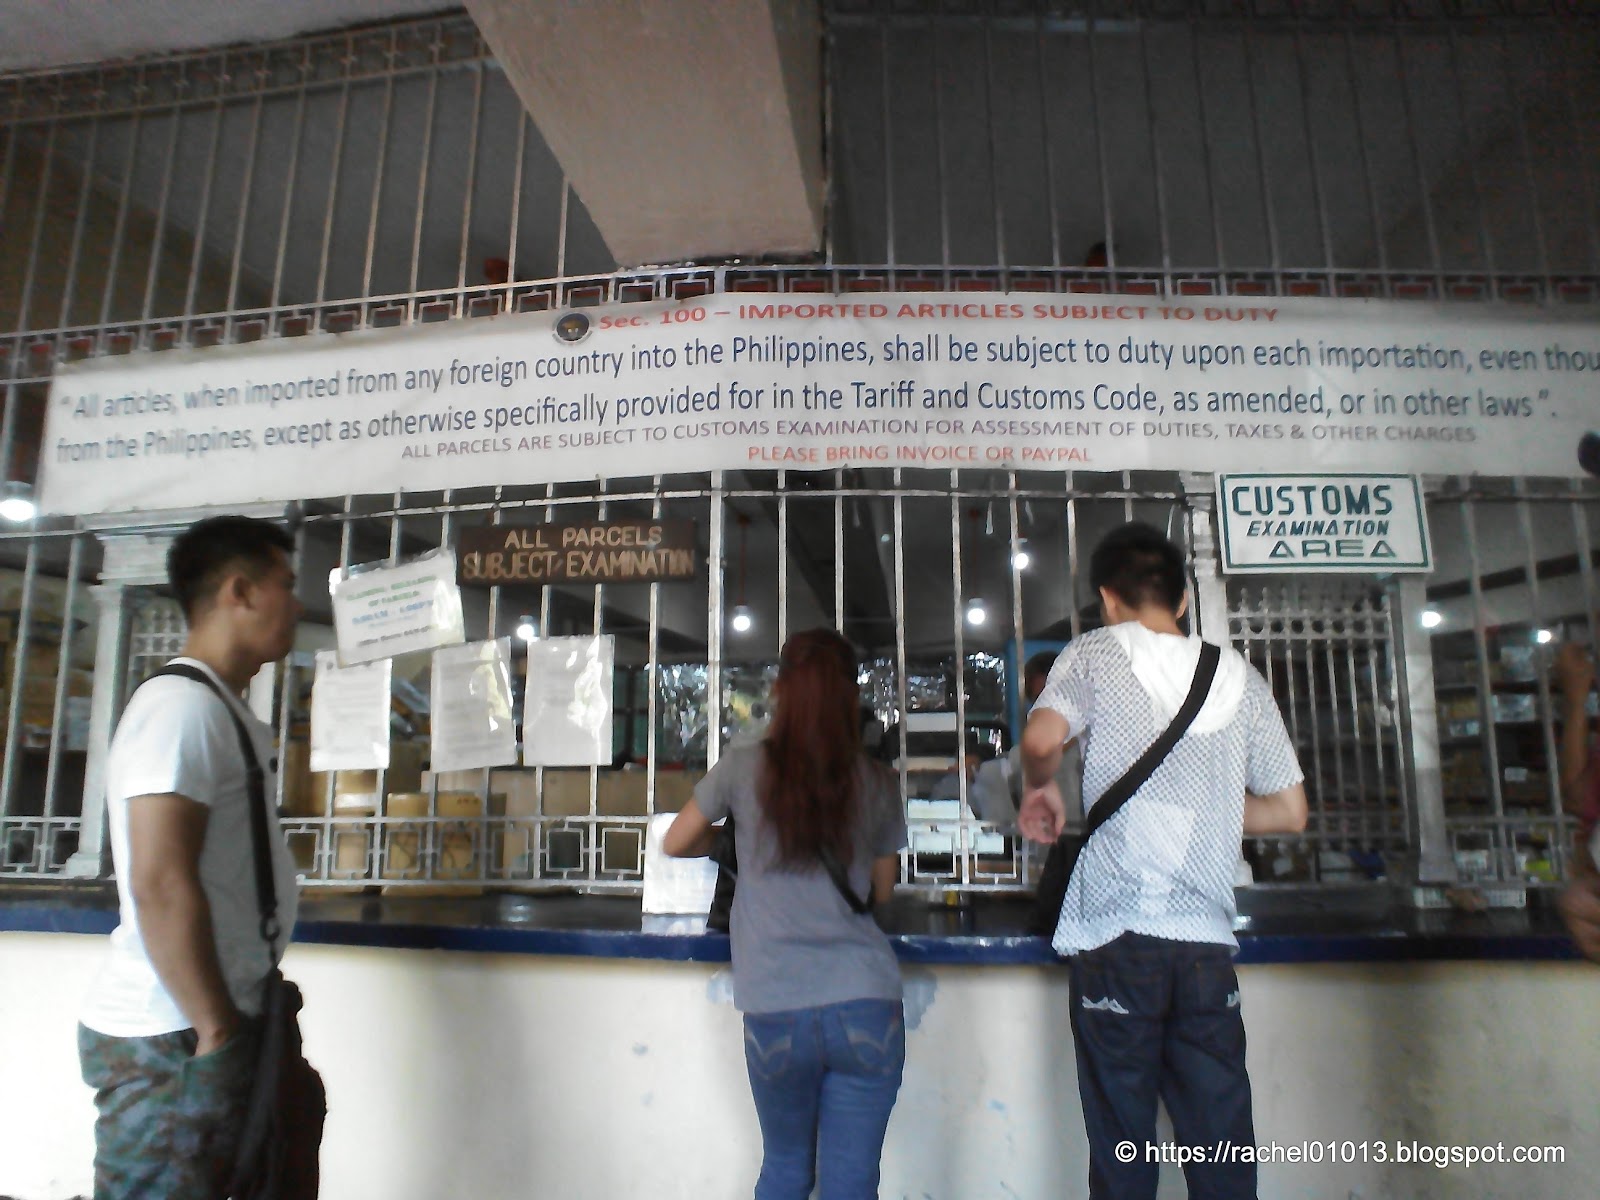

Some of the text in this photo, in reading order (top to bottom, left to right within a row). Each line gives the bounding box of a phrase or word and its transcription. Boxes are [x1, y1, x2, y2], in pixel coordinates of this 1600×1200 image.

[600, 315, 650, 330] Sec.
[660, 306, 706, 325] 100
[739, 304, 888, 320] IMPORTED
[897, 304, 1024, 319] ARTICLES
[1033, 304, 1148, 320] SUBJECT
[1158, 306, 1195, 321] TO
[1204, 307, 1278, 322] DUTY
[103, 388, 178, 416] articles,
[184, 382, 238, 410] when
[245, 370, 340, 408] imported
[347, 368, 397, 394] from
[404, 365, 442, 393] any
[450, 356, 528, 388] foreign
[535, 348, 624, 379] country
[631, 343, 677, 371] into
[685, 337, 724, 366] the
[732, 334, 875, 368] Philippines,
[883, 333, 939, 362] shall
[949, 333, 979, 363] be
[986, 334, 1077, 369] subject
[1084, 338, 1110, 364] to
[1118, 336, 1174, 370] duty
[1182, 342, 1245, 371] upon
[1253, 338, 1311, 367] each
[1318, 339, 1473, 374] importation,
[1479, 348, 1538, 371] even
[56, 437, 100, 463] from
[106, 432, 137, 459] the
[144, 426, 257, 459] Philippines,
[264, 418, 333, 449] except
[338, 419, 361, 440] as
[367, 405, 476, 439] otherwise
[484, 393, 608, 433] specifically
[616, 383, 720, 423] provided
[729, 381, 764, 411] for
[773, 382, 795, 410] in
[802, 382, 843, 410] the
[850, 380, 917, 410] Tariff
[923, 381, 969, 410] and
[977, 381, 1086, 411] Customs
[1093, 382, 1165, 417] Code,
[1173, 389, 1200, 413] as
[1207, 385, 1332, 418] amended,
[1340, 392, 1367, 414] or
[1373, 387, 1397, 414] in
[1404, 387, 1471, 417] other
[402, 419, 1477, 460] ALL PARCELS ARE SUBJECT TO CUSTOMS EXAMINATION FOR ASSESSMENT OF DUTIES, TAXES & OTHER CHARGES
[748, 445, 1093, 463] PLEASE BRING INVOICE OR PAYPAL
[1231, 484, 1393, 516] CUSTOMS
[504, 526, 663, 549] ALL PARCELS
[1246, 519, 1391, 537] EXAMINATION
[1268, 539, 1397, 558] AREA
[463, 550, 558, 580] SUBJECT
